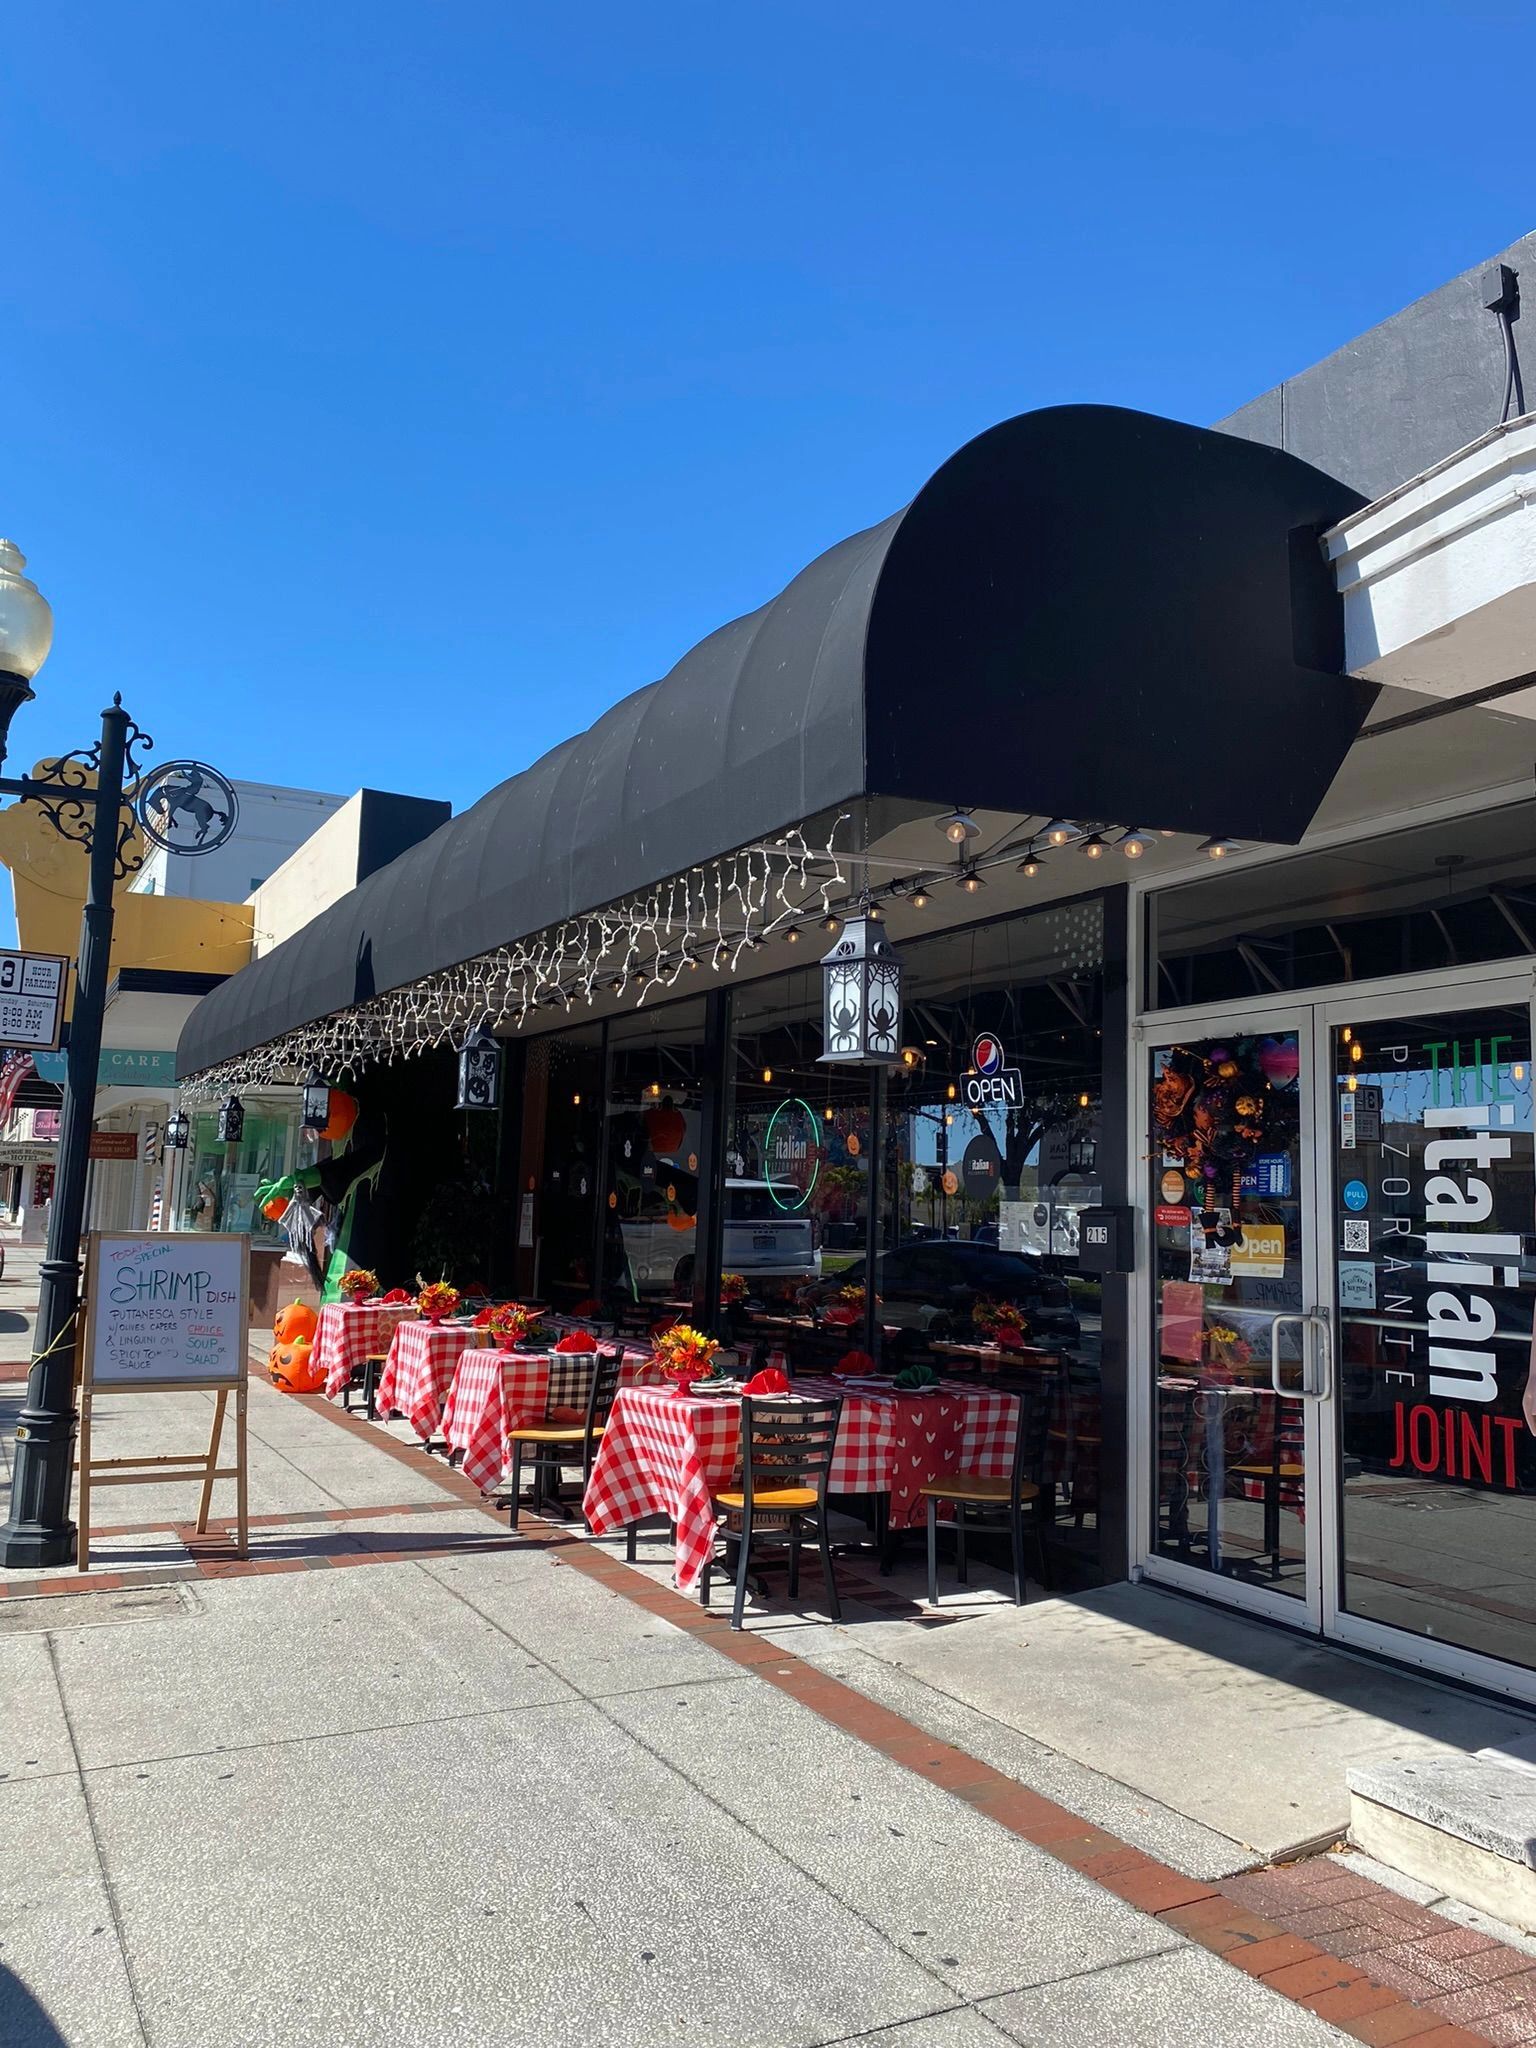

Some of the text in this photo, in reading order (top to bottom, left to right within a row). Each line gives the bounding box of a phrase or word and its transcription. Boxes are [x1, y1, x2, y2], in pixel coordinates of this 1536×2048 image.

[1, 960, 16, 988] 3
[32, 966, 52, 977] HOUR
[24, 977, 57, 990] PARKING
[26, 1009, 43, 1019] AM
[25, 1020, 41, 1030] PM
[112, 1054, 160, 1067] CARE
[1423, 1036, 1515, 1105] THE
[967, 1077, 1016, 1103] OPEN
[775, 1135, 806, 1160] italian
[1240, 1176, 1257, 1186] PEN
[1346, 1190, 1366, 1199] PULL
[1087, 1227, 1107, 1242] 215
[1232, 1232, 1283, 1259] Open
[1424, 1104, 1521, 1402] italian
[109, 1266, 236, 1304] SHRIMP DISH
[109, 1308, 213, 1320] PUTTANESCA STYLE
[150, 1322, 177, 1331] CAPERS
[187, 1324, 222, 1335] CHOICE
[185, 1337, 218, 1349] SOUP
[109, 1349, 140, 1361] SPICY
[185, 1352, 220, 1365] SALAD
[118, 1359, 153, 1370] SAUCE
[1389, 1401, 1523, 1488] JOINT
